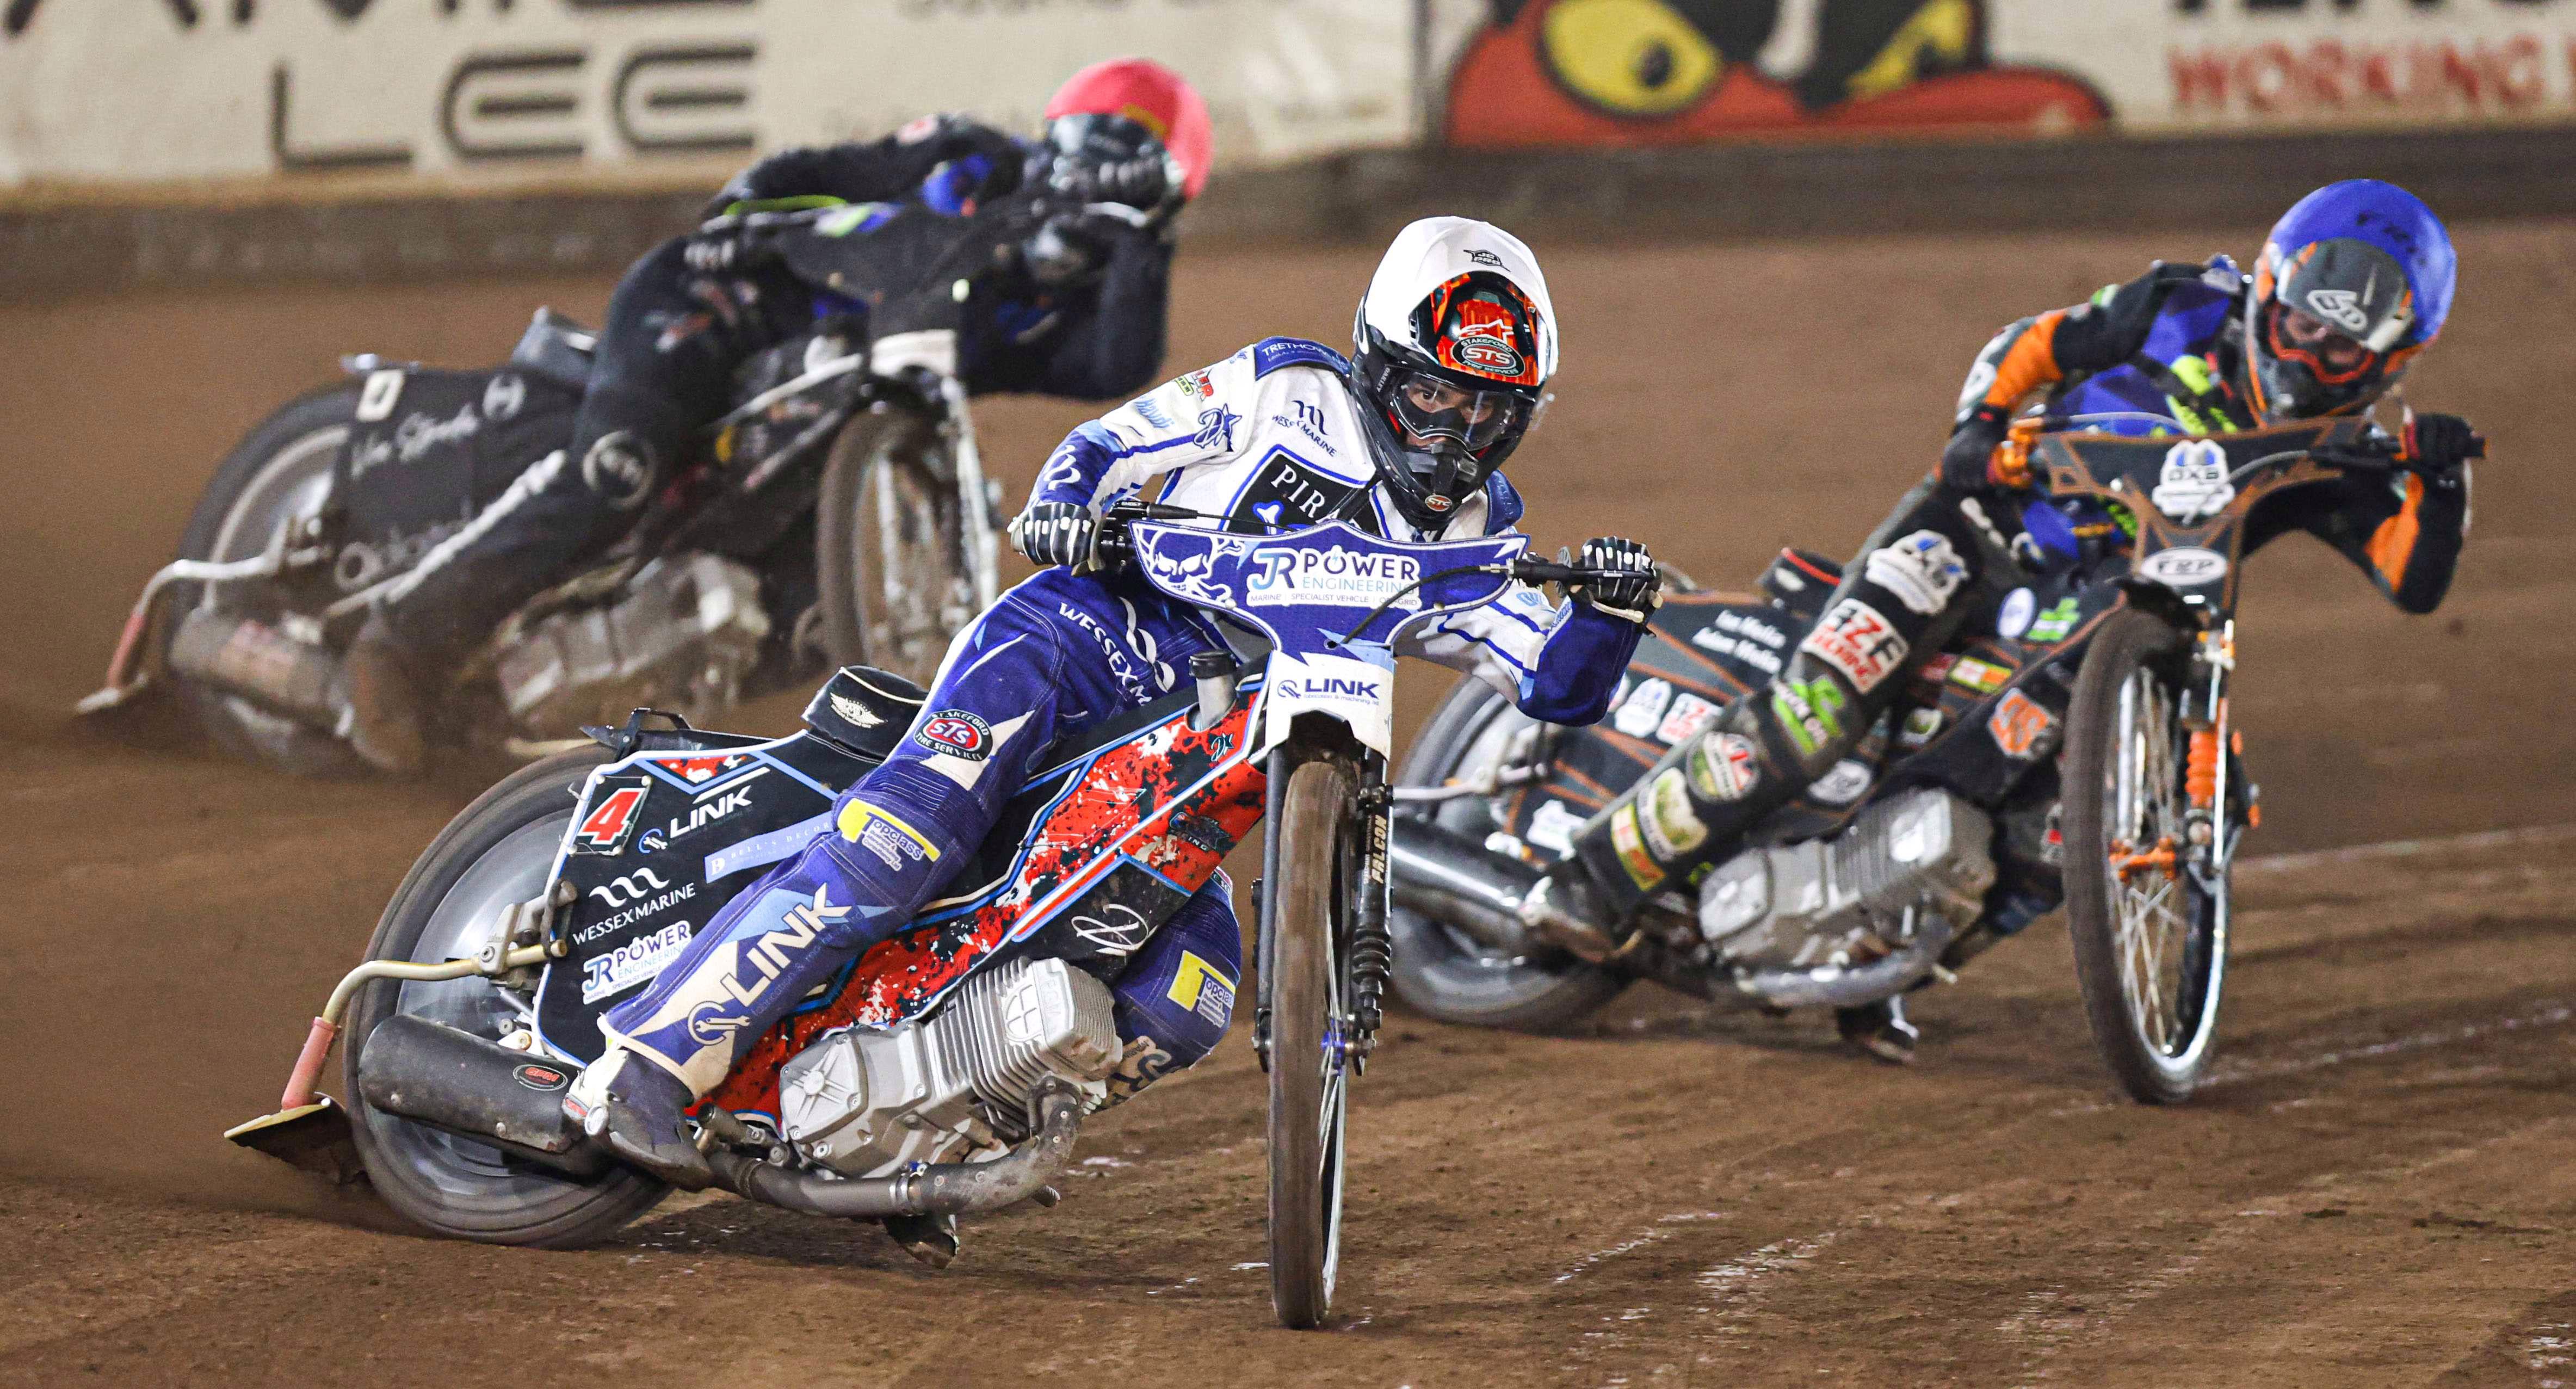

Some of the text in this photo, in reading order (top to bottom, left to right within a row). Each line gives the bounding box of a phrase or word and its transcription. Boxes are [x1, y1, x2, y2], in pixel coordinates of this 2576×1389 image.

[270, 42, 756, 166] LEE
[1461, 337, 1514, 353] STAKEFORD
[1466, 347, 1511, 364] STS
[1484, 366, 1519, 375] SERVICES
[1272, 414, 1337, 457] WESSXMARINE
[1252, 553, 1416, 590] JR POWER
[1379, 597, 1417, 605] O-GRID
[1305, 678, 1380, 699] LINK
[930, 721, 971, 744] STS
[931, 711, 990, 736] STAKEFORD
[915, 732, 983, 761] TYRE SERVICES
[578, 788, 645, 844] 4
[670, 785, 752, 838] LINK
[1372, 814, 1387, 884] FALCON
[585, 924, 688, 991] JR POWER
[720, 882, 853, 1007] LINK
